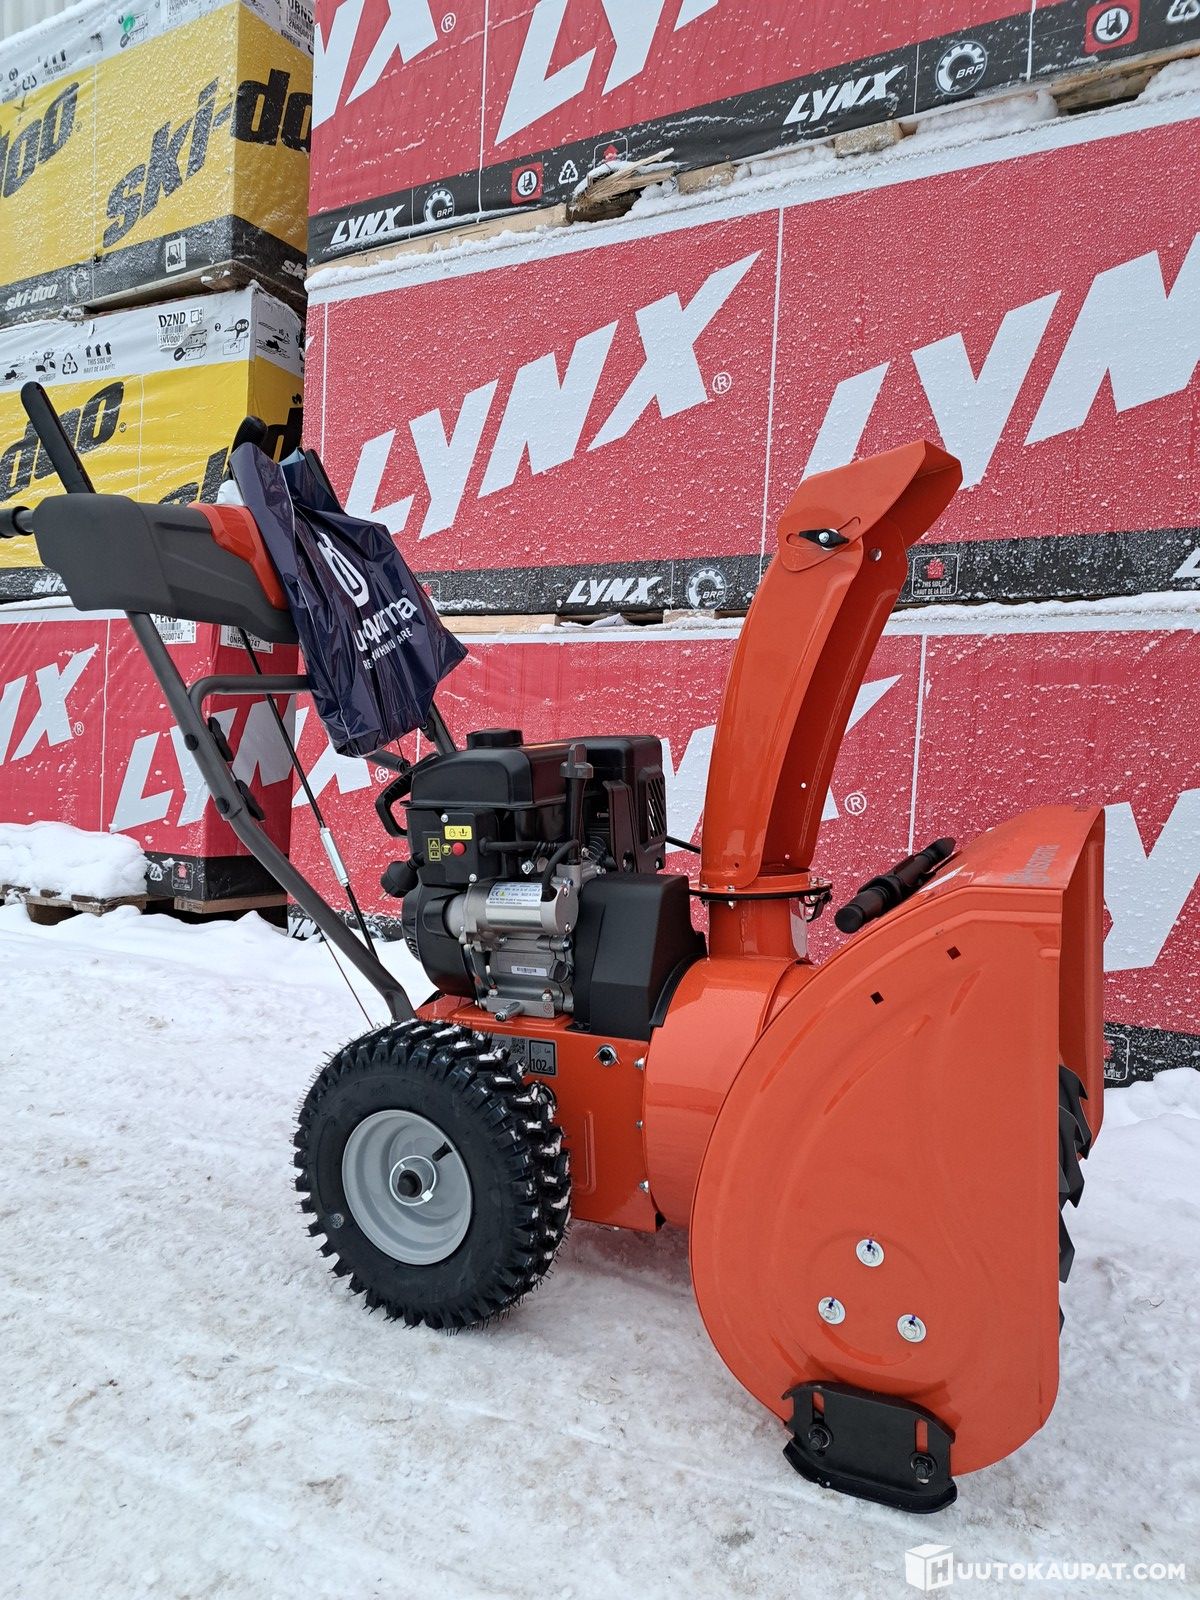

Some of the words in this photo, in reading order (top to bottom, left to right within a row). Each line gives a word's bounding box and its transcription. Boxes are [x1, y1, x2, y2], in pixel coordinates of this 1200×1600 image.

[955, 63, 985, 79] BRP
[783, 66, 907, 125] LYNX
[436, 206, 454, 219] BRP
[330, 203, 405, 245] LYNX
[4, 283, 59, 312] ski-doo
[158, 311, 186, 328] DZND
[344, 249, 763, 541] LYNX
[565, 577, 663, 606] LYNX
[702, 590, 725, 599] BRP
[396, 627, 413, 644] ARE
[531, 1059, 548, 1072] 102
